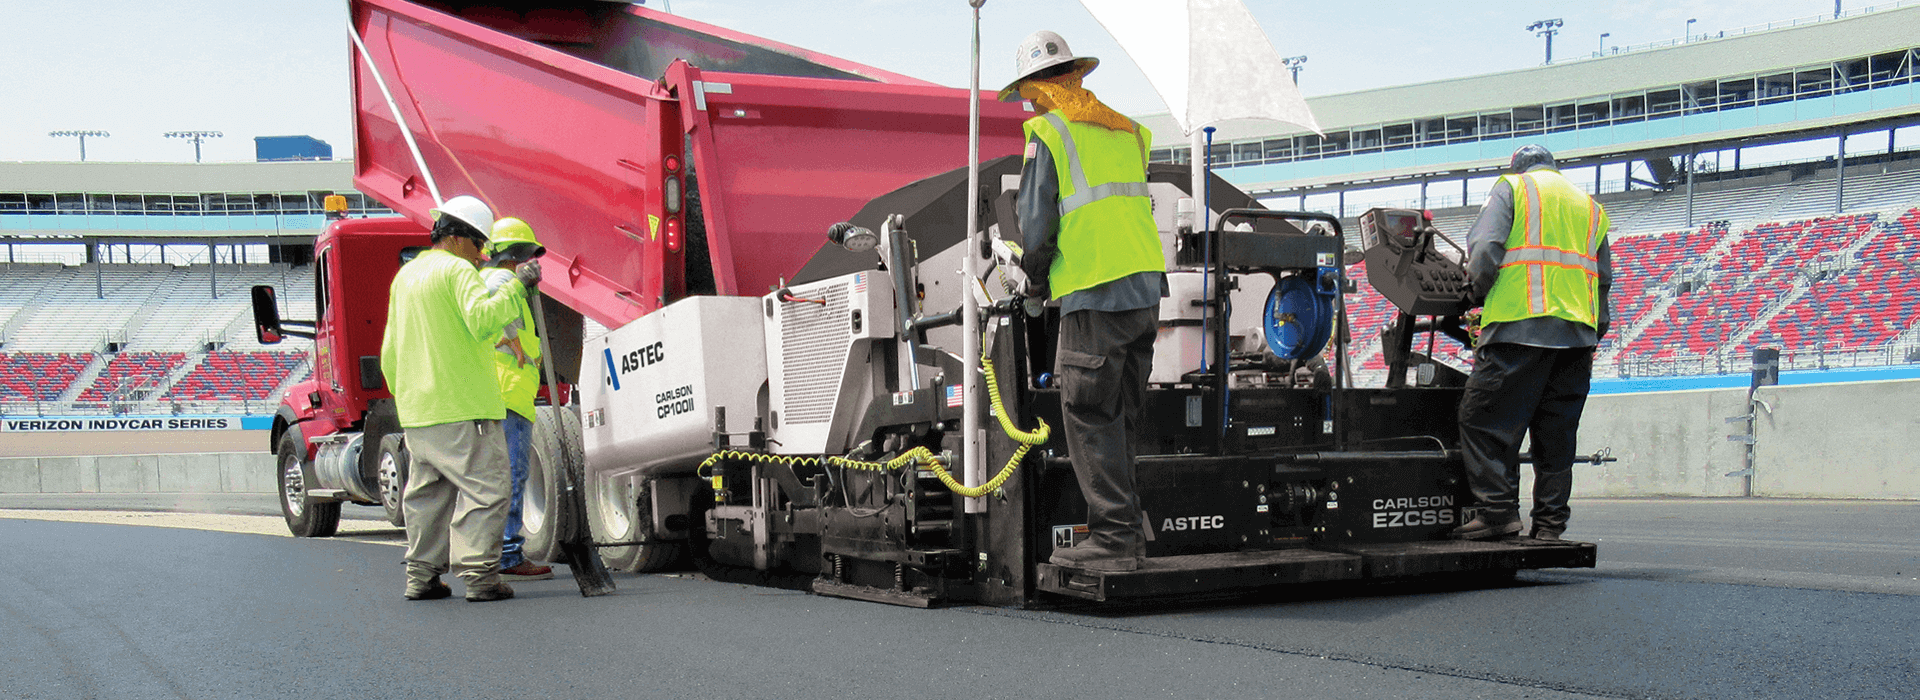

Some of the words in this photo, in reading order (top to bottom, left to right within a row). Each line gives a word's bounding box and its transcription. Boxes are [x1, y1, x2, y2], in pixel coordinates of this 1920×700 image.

[621, 340, 665, 375] ASTEC
[655, 384, 693, 404] CARLSON
[7, 420, 83, 431] VERIZON
[88, 419, 163, 430] INDYCAR
[167, 418, 228, 430] SERIES
[1372, 495, 1454, 510] CARLSON
[1161, 514, 1225, 532] ASTEC
[1372, 508, 1454, 529] EZCSS
